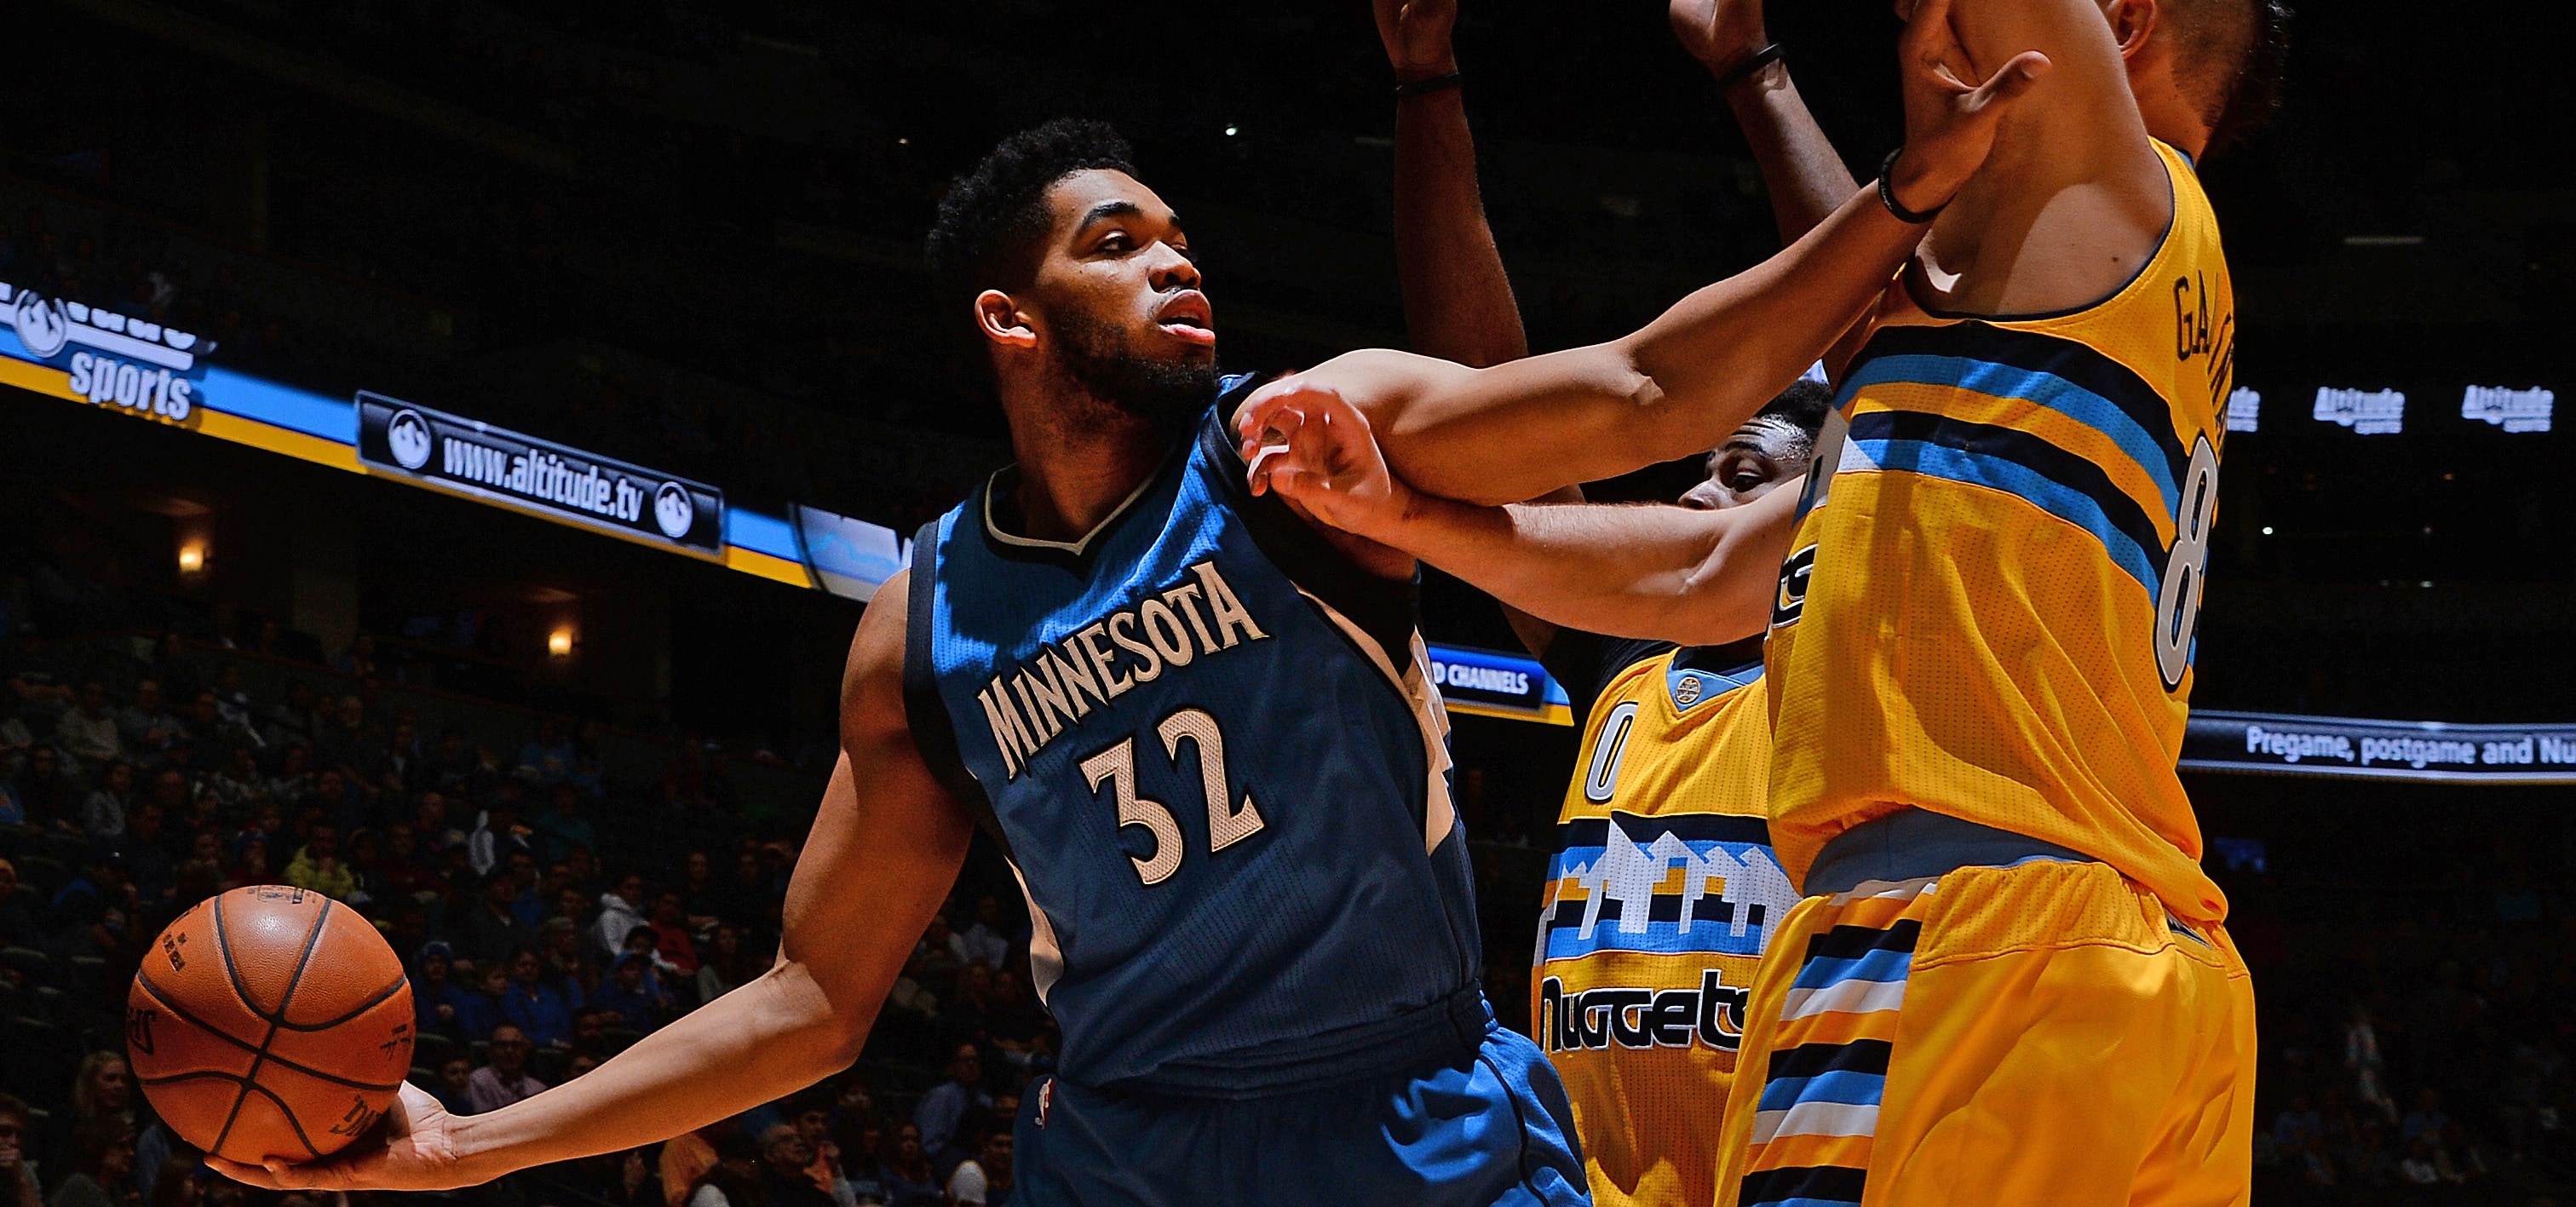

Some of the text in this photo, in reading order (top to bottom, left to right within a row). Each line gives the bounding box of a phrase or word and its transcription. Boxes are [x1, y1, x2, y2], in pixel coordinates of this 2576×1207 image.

[69, 352, 192, 421] sports
[443, 437, 644, 522] www.altitude.tv
[2155, 433, 2219, 688] 8
[977, 560, 1271, 780] MINNESOTA
[1448, 664, 1529, 695] CHANNELS
[2245, 725, 2355, 762] Pregame,
[2360, 736, 2475, 768] postgame
[2481, 734, 2534, 764] and
[1078, 708, 1265, 885] 32
